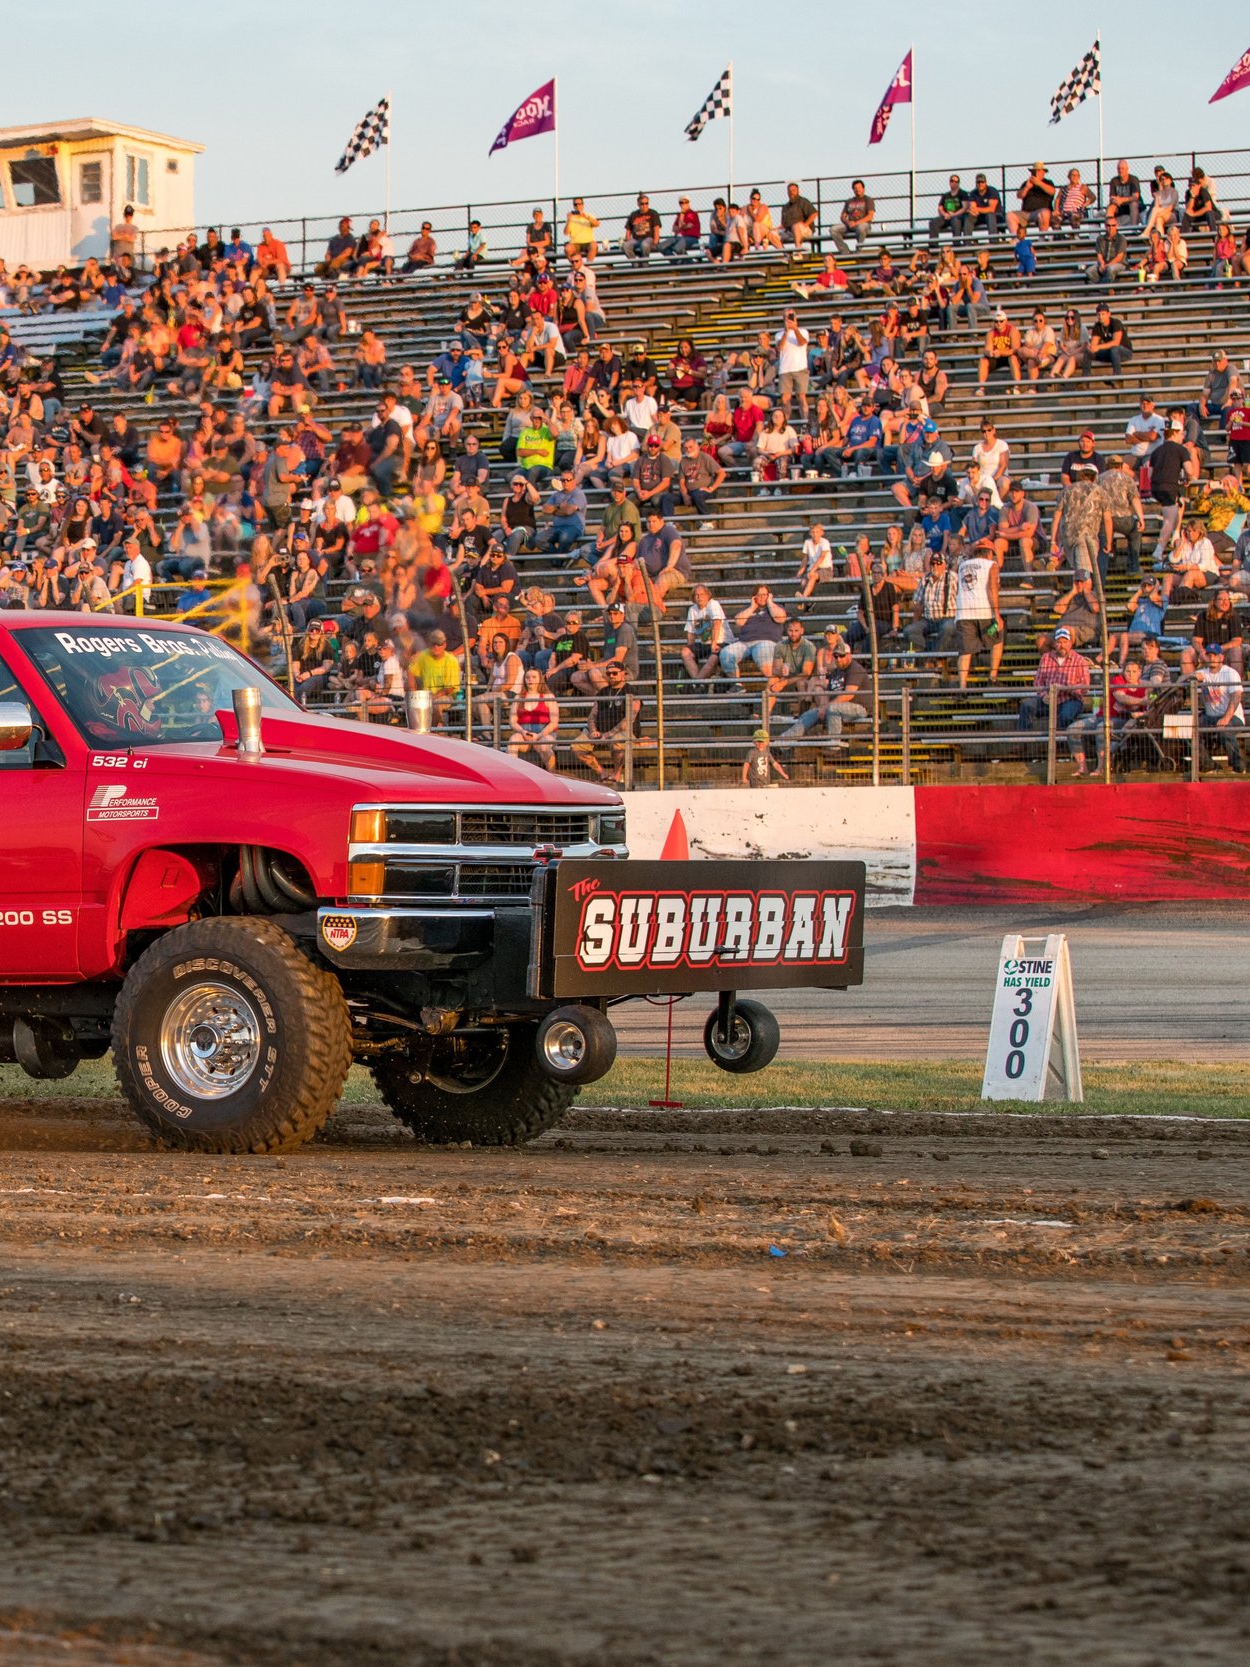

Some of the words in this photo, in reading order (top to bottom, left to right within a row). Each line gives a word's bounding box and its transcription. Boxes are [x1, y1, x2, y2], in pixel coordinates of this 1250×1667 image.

[54, 632, 143, 657] Rogers
[137, 633, 201, 656] Bros.
[92, 756, 128, 768] 532
[133, 758, 148, 769] ci
[89, 785, 157, 807] PERFORMANCE
[98, 810, 149, 818] MOTORSPORTS
[567, 877, 601, 901] The
[42, 910, 73, 925] SS
[330, 928, 349, 939] NTPA
[578, 896, 853, 964] SUBURBAN
[1018, 960, 1053, 974] STINE
[1003, 977, 1022, 988] HAS
[1025, 977, 1051, 988] YIELD
[172, 957, 277, 1034] DISCOVERER
[135, 1045, 193, 1119] COOPER
